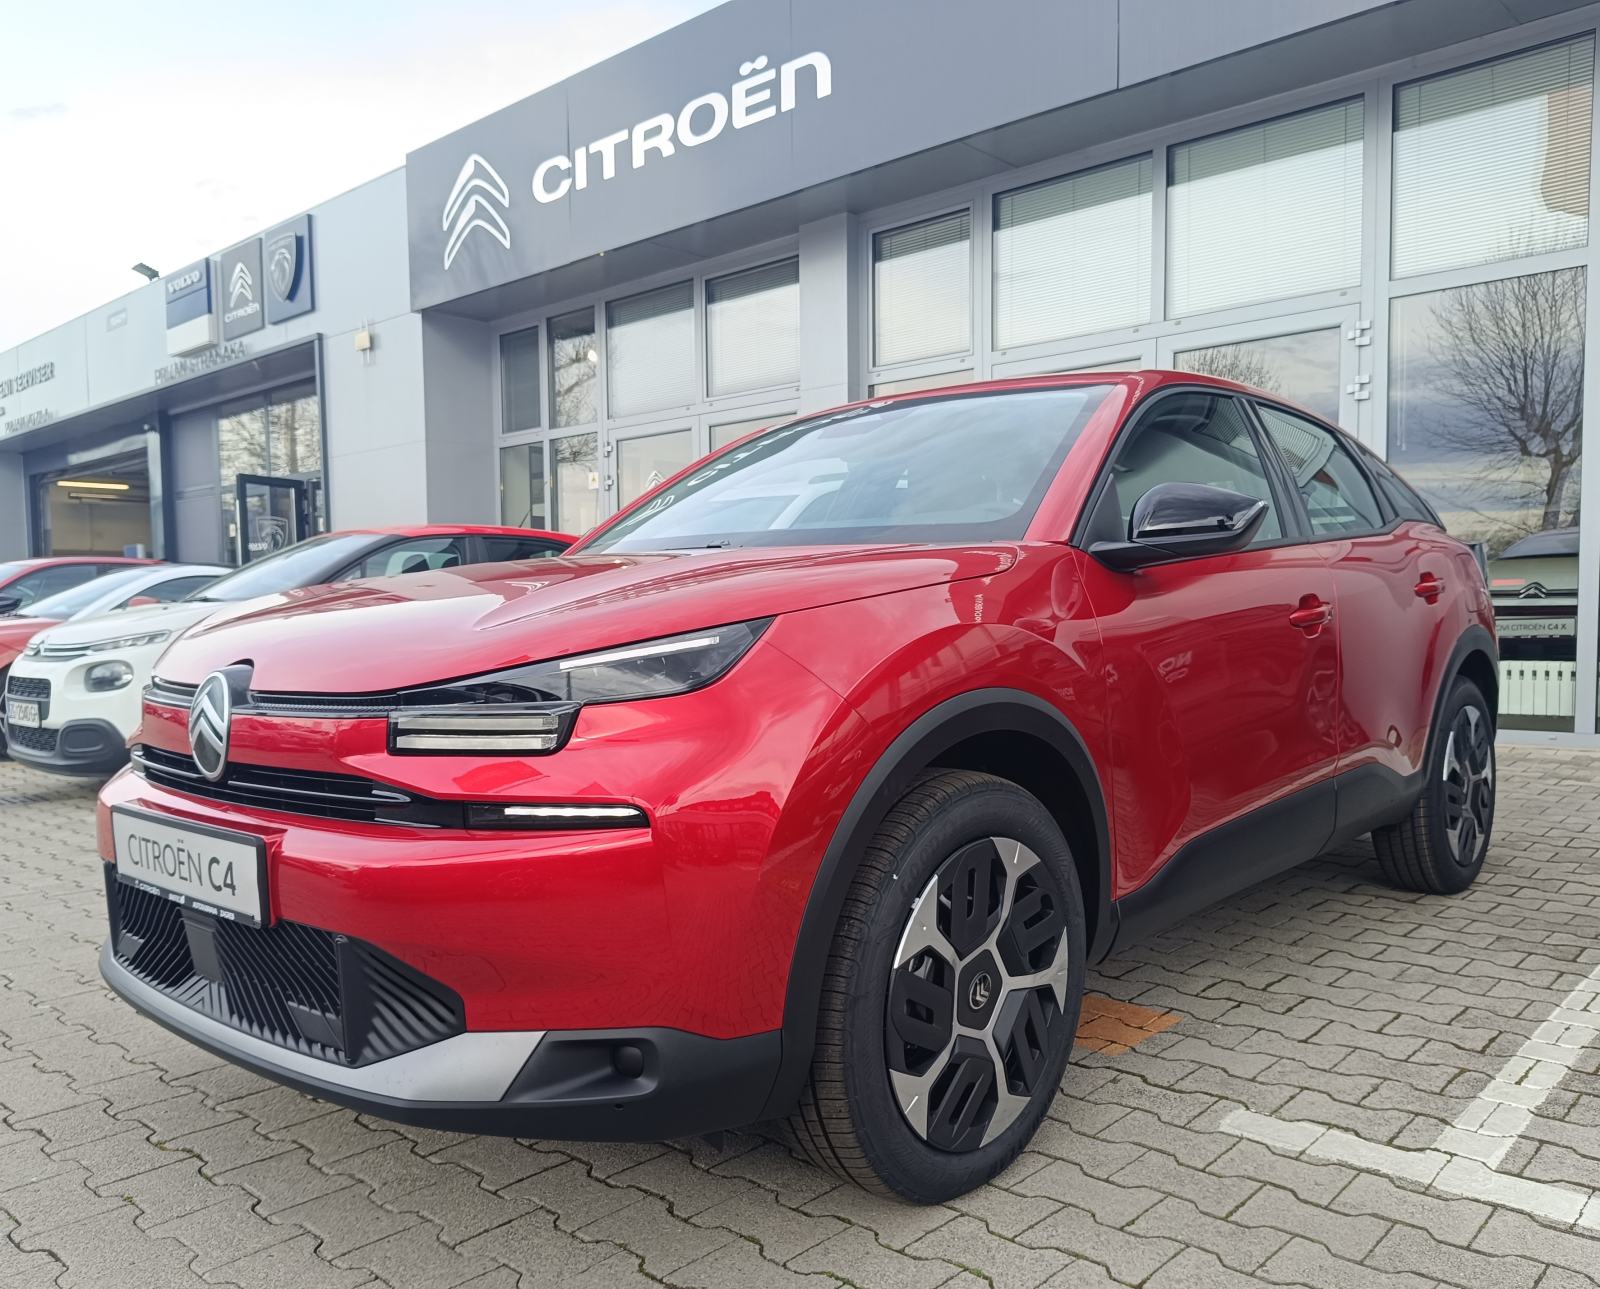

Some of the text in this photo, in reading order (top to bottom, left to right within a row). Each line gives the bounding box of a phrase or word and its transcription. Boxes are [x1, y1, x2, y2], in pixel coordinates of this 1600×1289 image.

[532, 51, 832, 204] CITROËN
[224, 302, 260, 323] CITROËN
[1547, 623, 1559, 631] C4
[1560, 623, 1567, 631] X
[128, 833, 236, 896] CITROËN C4
